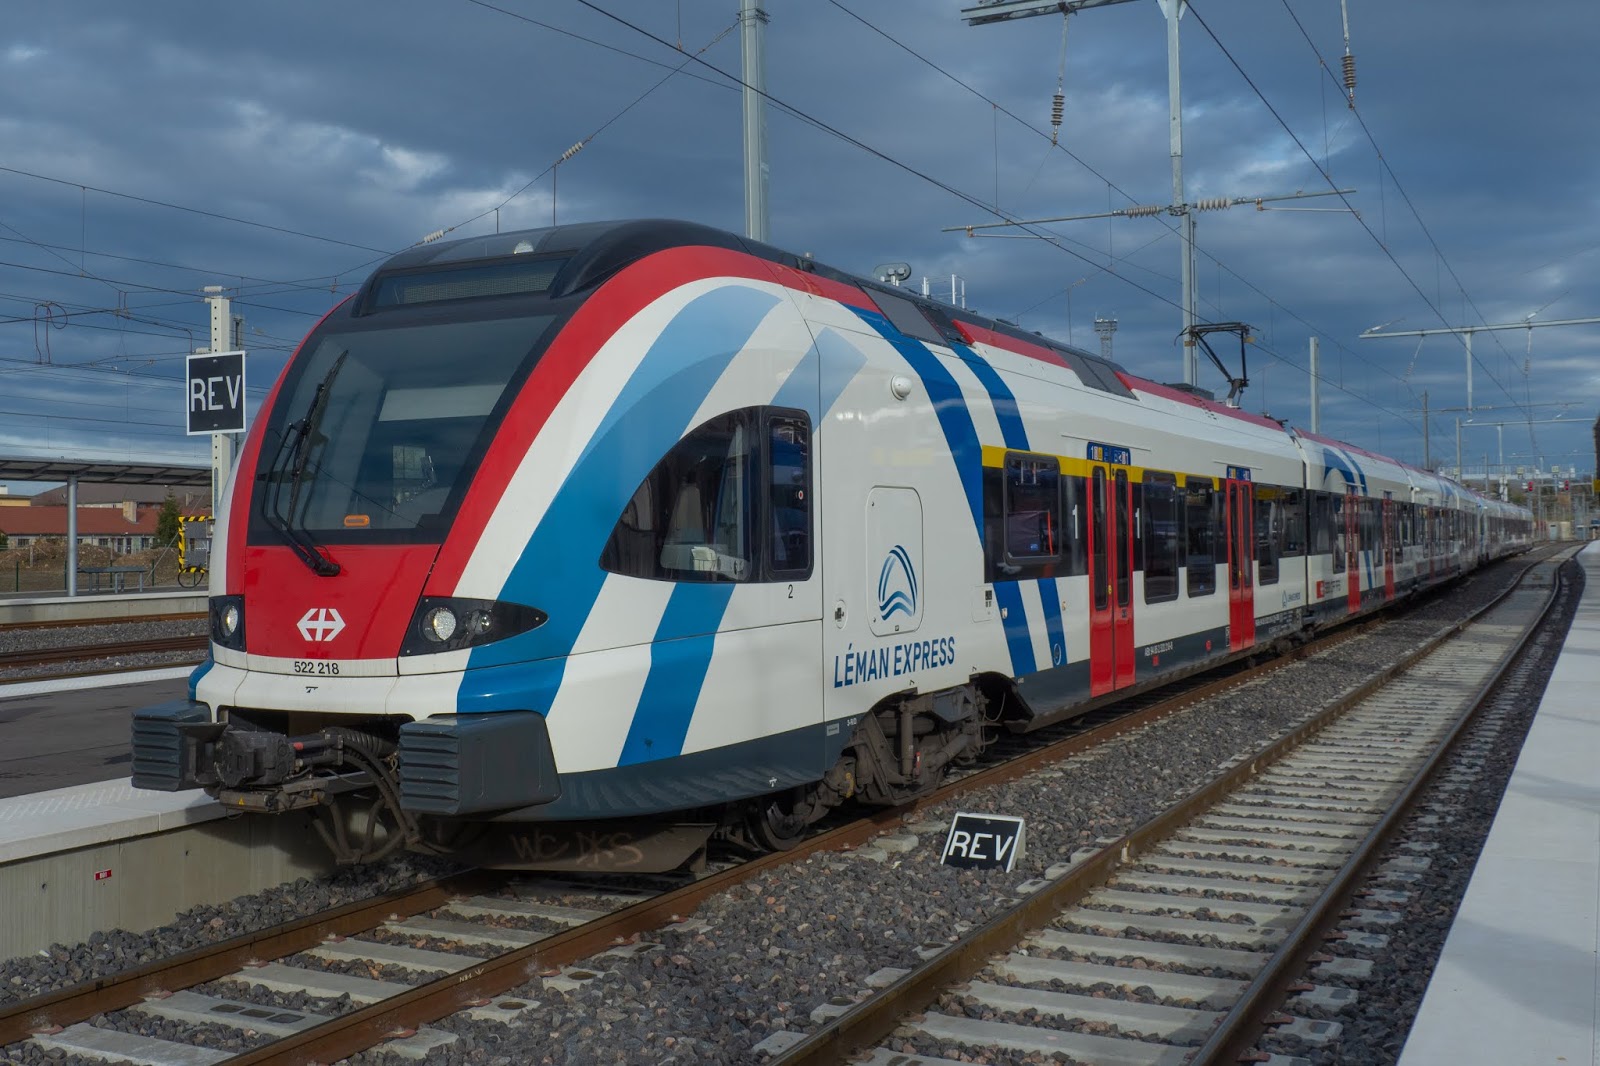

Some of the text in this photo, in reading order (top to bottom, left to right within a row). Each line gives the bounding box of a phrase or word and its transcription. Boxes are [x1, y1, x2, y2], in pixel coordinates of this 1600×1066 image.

[190, 374, 242, 412] REV
[1072, 504, 1079, 540] 1
[1134, 507, 1141, 539] 1
[787, 583, 794, 599] 2
[294, 660, 340, 675] 522 218
[833, 636, 955, 688] LÉMAN EXPRESS
[947, 830, 1014, 861] REV
